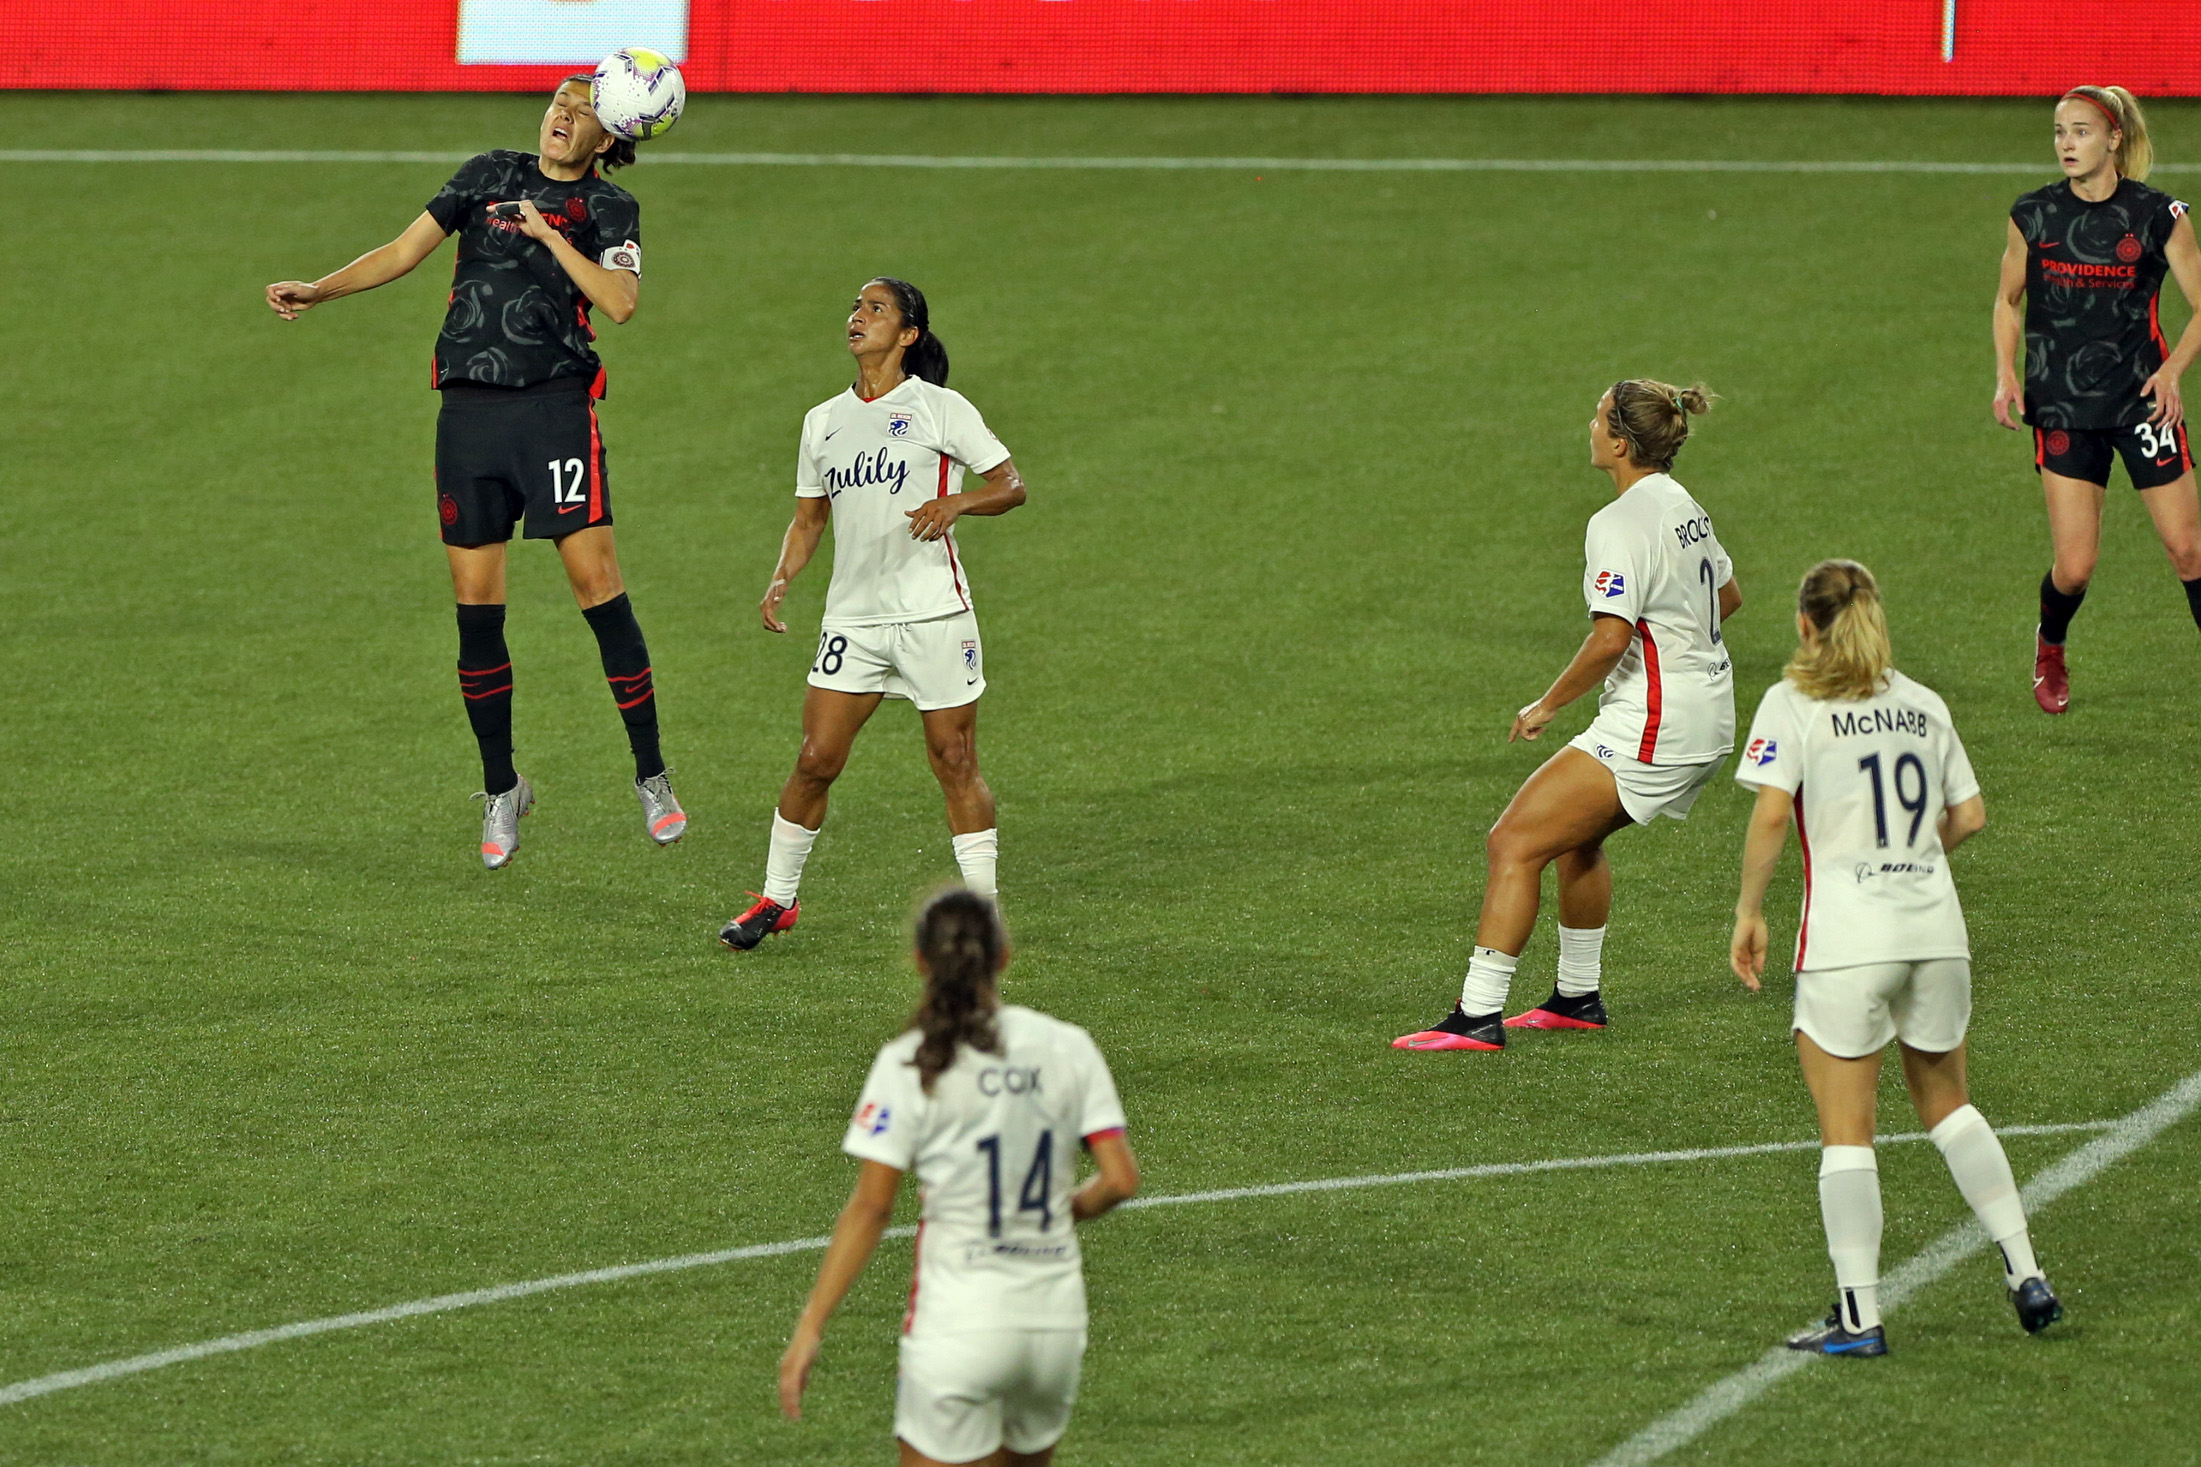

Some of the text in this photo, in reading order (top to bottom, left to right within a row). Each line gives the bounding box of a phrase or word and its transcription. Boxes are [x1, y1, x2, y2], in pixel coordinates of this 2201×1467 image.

[2041, 259, 2136, 277] PROVIDENCE
[2077, 278, 2085, 288] &
[2089, 279, 2135, 289] Services
[2134, 422, 2178, 459] 34
[548, 458, 587, 504] 12
[812, 631, 847, 675] 28
[1832, 708, 1927, 738] McNABB
[1859, 752, 1928, 849] 19
[977, 1067, 1042, 1098] COX
[976, 1129, 1054, 1239] 14
